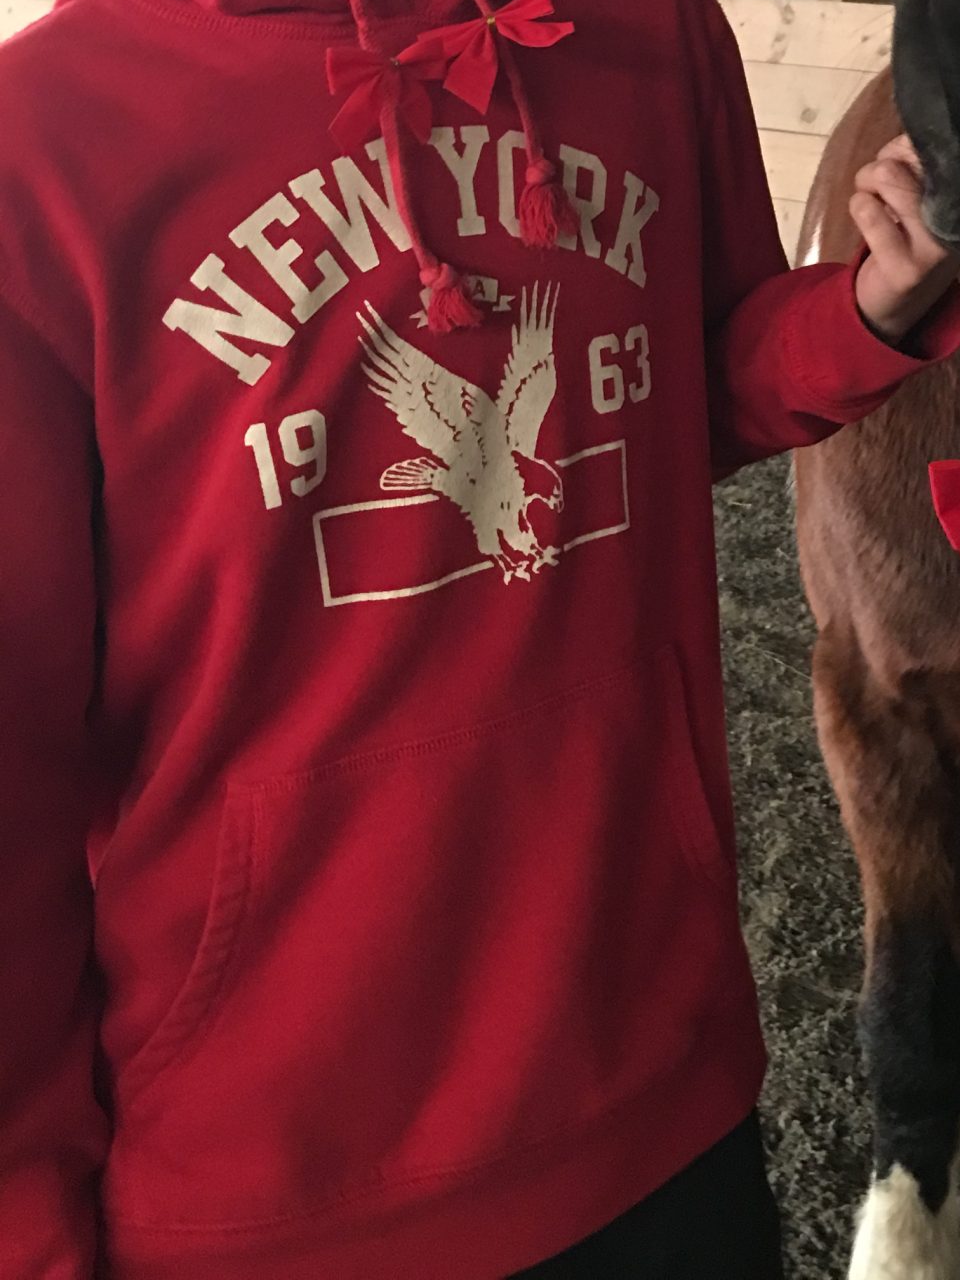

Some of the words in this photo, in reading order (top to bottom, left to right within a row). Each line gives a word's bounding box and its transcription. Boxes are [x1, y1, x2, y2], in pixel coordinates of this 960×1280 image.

[162, 137, 413, 386] NEW
[427, 124, 661, 289] YORK
[588, 323, 651, 414] 63
[244, 408, 327, 510] 19
